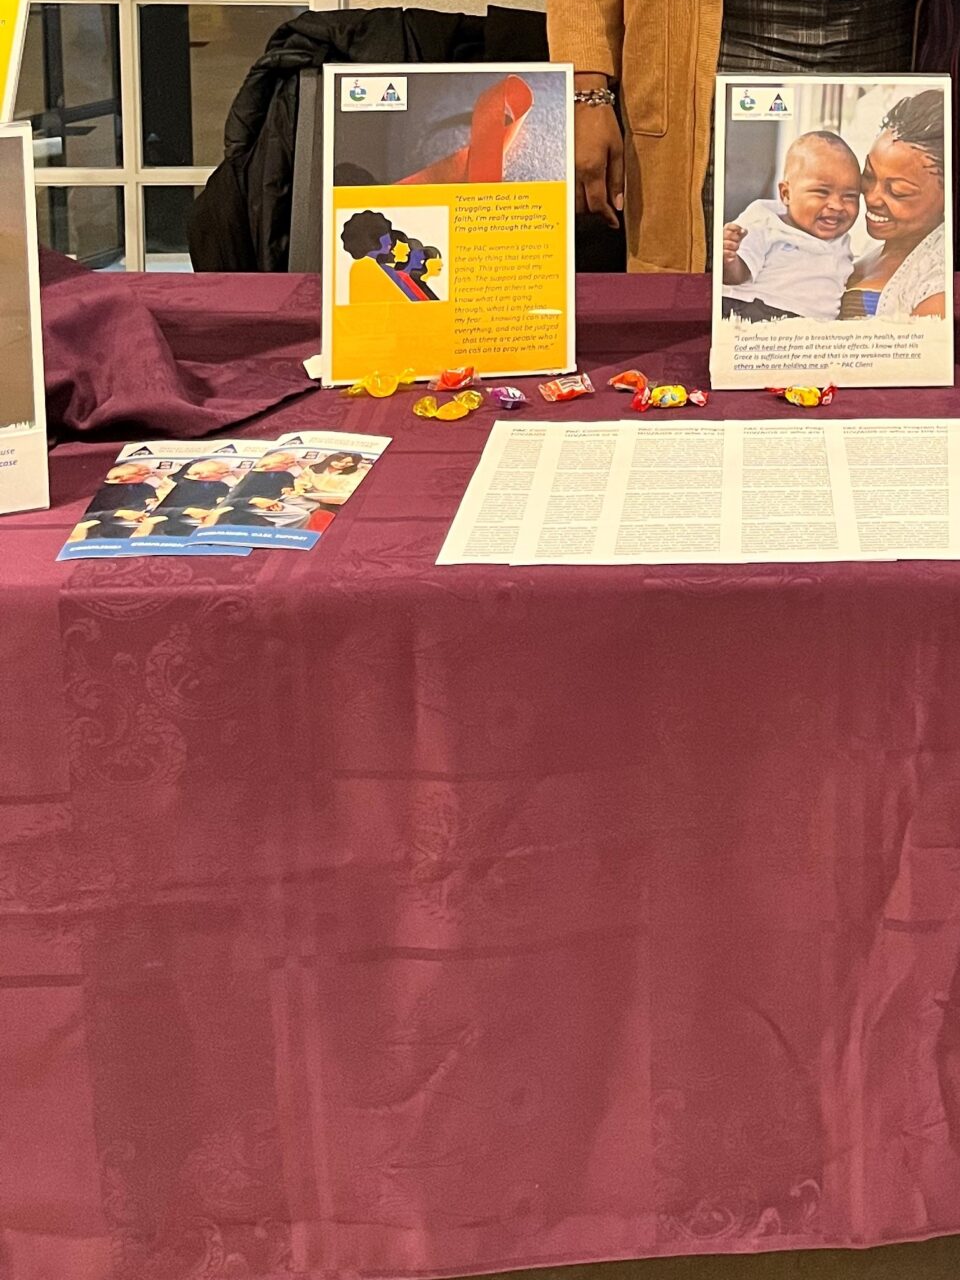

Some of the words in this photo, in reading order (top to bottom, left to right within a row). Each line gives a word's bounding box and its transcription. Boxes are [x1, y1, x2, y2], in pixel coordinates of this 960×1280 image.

[794, 333, 804, 342] for
[811, 333, 854, 342] breakthrough
[788, 343, 804, 352] from
[815, 342, 832, 350] these
[761, 352, 790, 362] sufficient
[791, 352, 800, 361] for
[861, 351, 891, 359] weakness
[783, 361, 808, 370] holding
[842, 360, 854, 368] PAC
